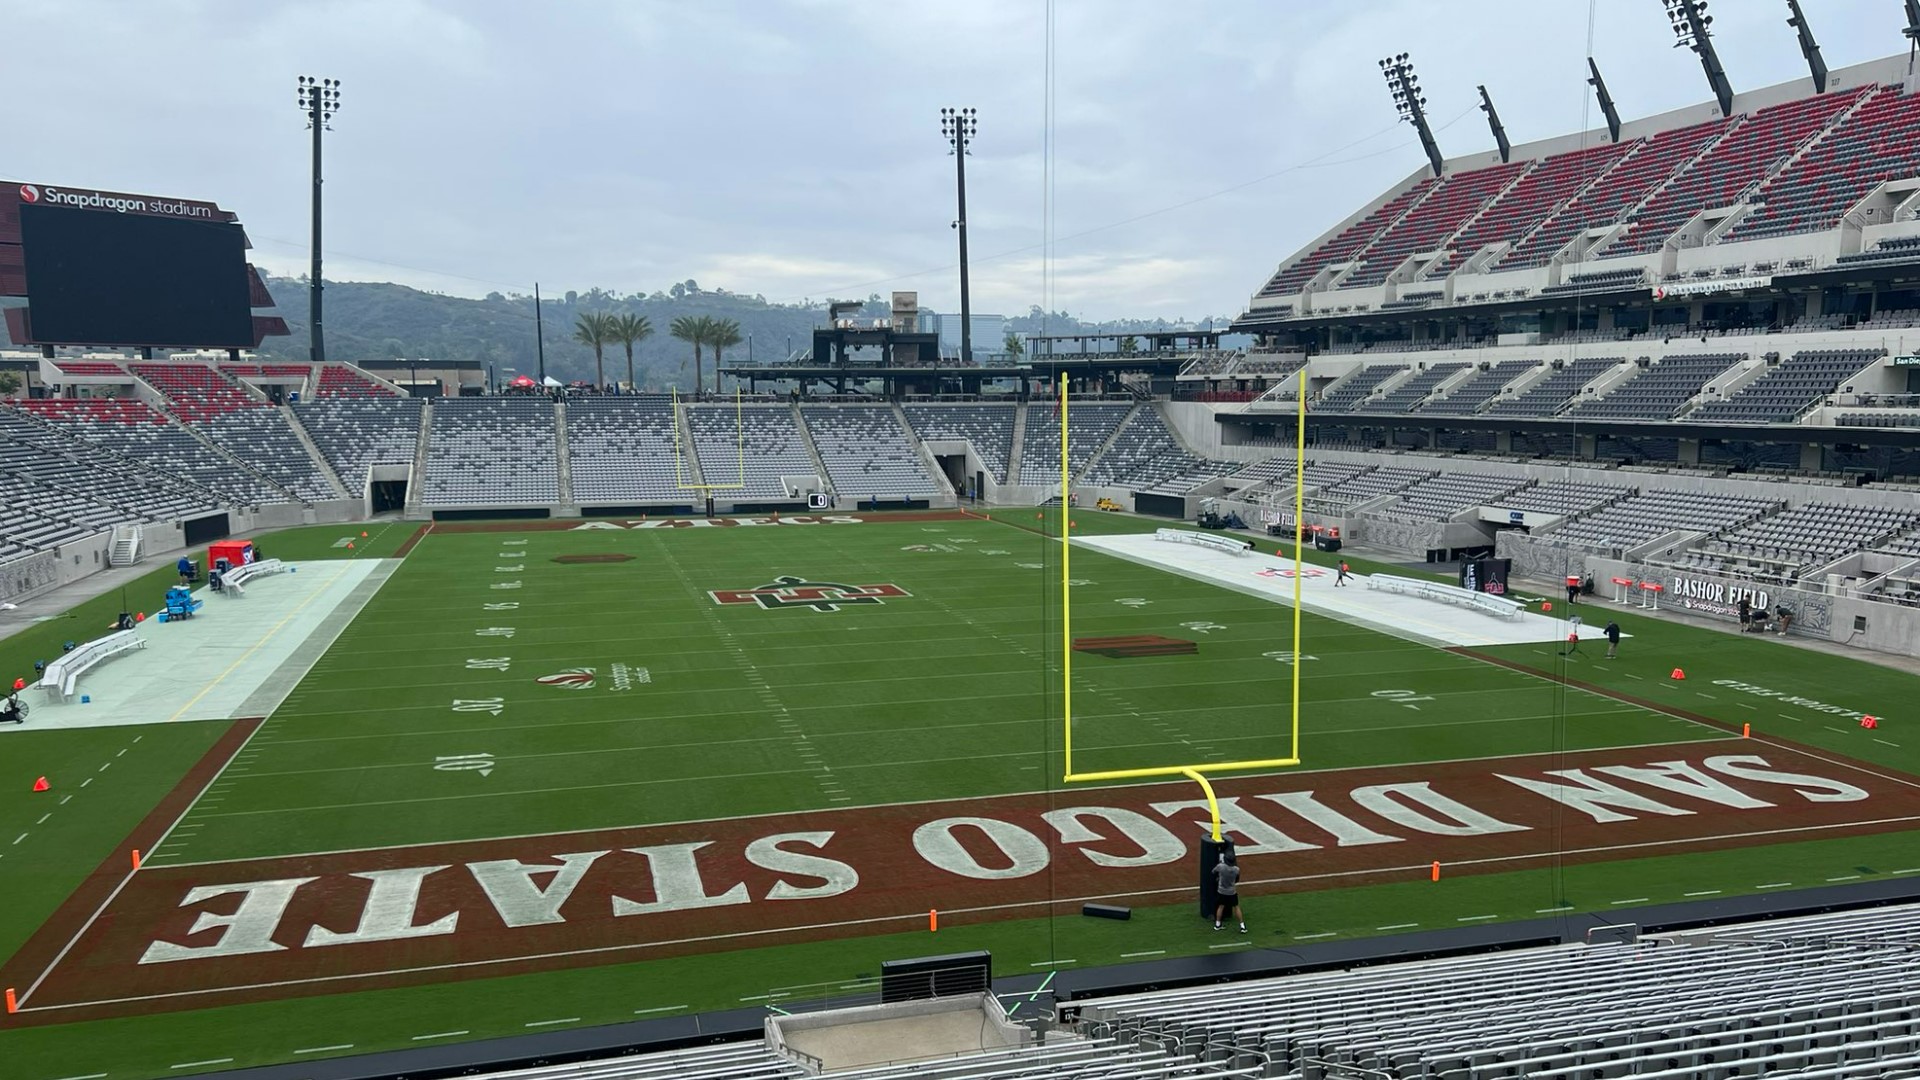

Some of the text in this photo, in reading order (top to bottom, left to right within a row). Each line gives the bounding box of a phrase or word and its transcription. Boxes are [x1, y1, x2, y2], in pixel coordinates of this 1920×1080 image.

[45, 188, 211, 217] Snapdragon stadium
[1896, 357, 1920, 366] San Die
[568, 515, 864, 531] AZTECS
[1674, 577, 1725, 603] BASHOR
[1692, 600, 1728, 614] Snapdragon
[452, 698, 504, 712] 20
[433, 753, 495, 771] 10
[138, 755, 1870, 965] SAN DIEGO STATE
